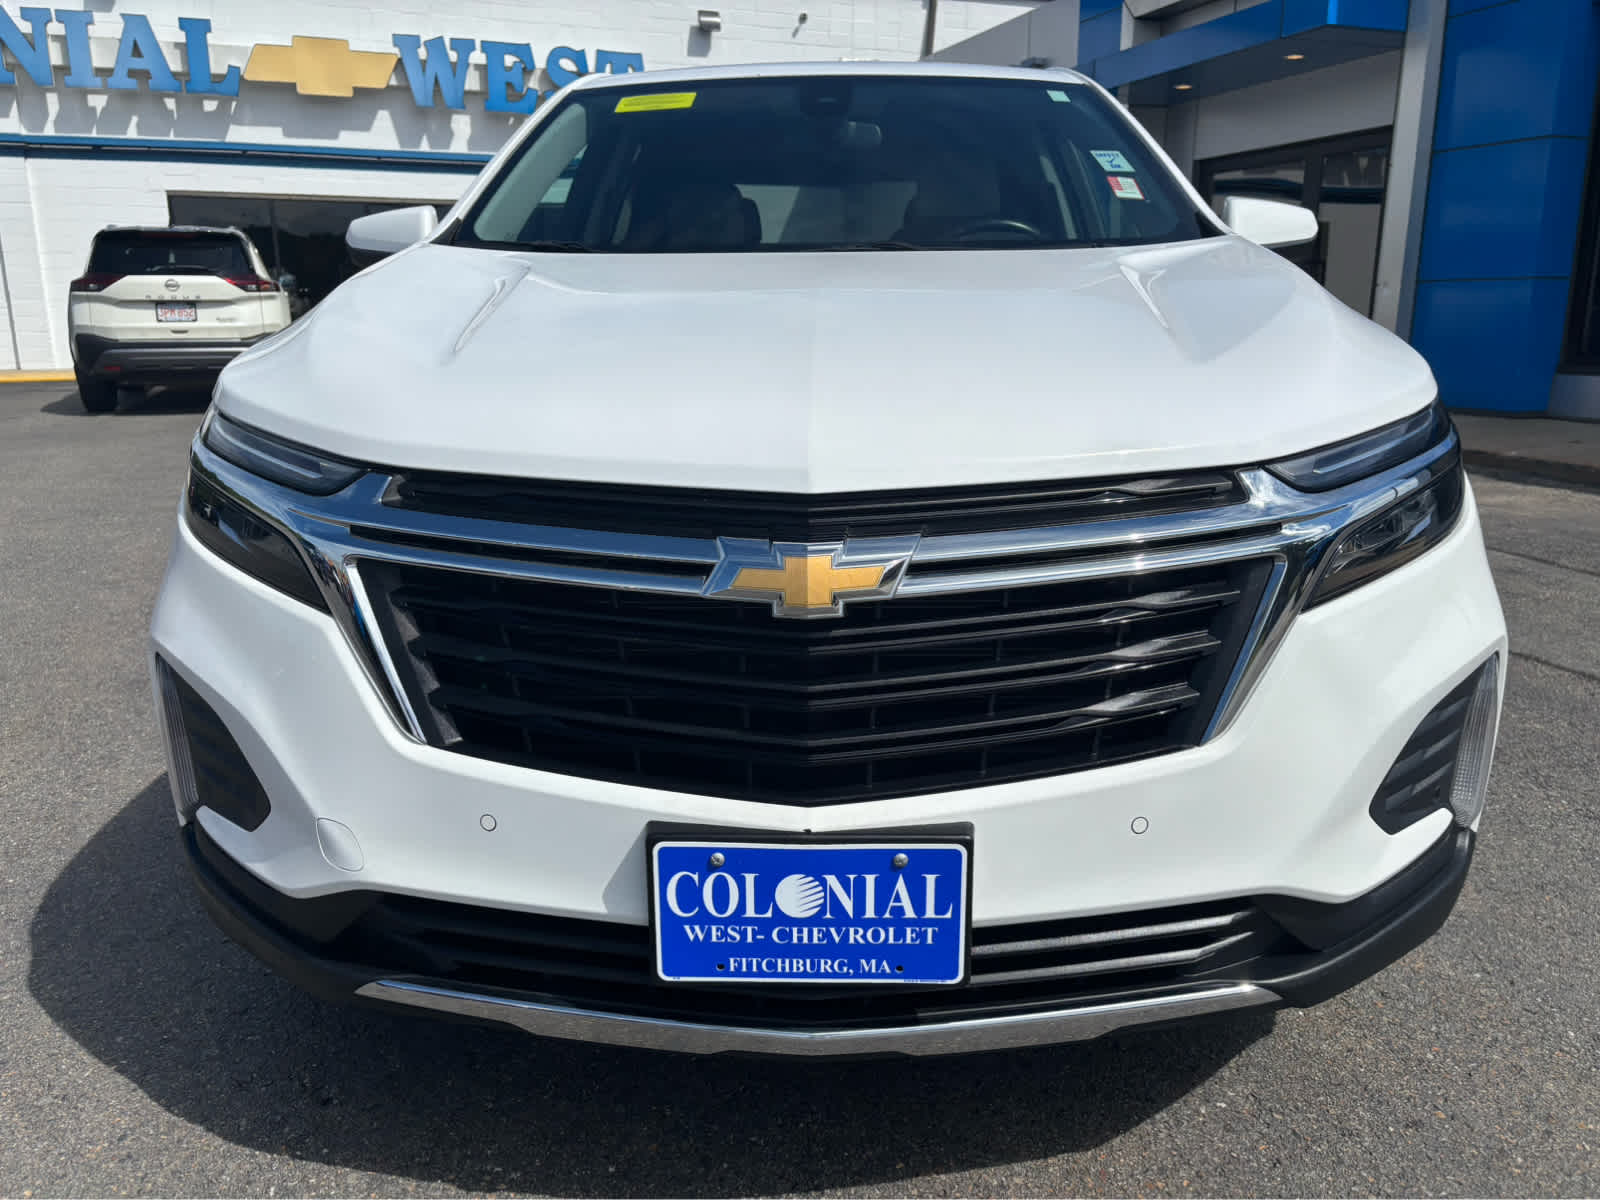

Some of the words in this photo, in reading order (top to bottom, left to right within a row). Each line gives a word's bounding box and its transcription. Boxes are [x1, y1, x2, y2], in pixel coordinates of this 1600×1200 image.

[666, 871, 952, 919] COLONIAL
[772, 926, 938, 945] CHEVROLET
[729, 957, 854, 976] FITCHBURG,
[860, 959, 891, 974] MA
